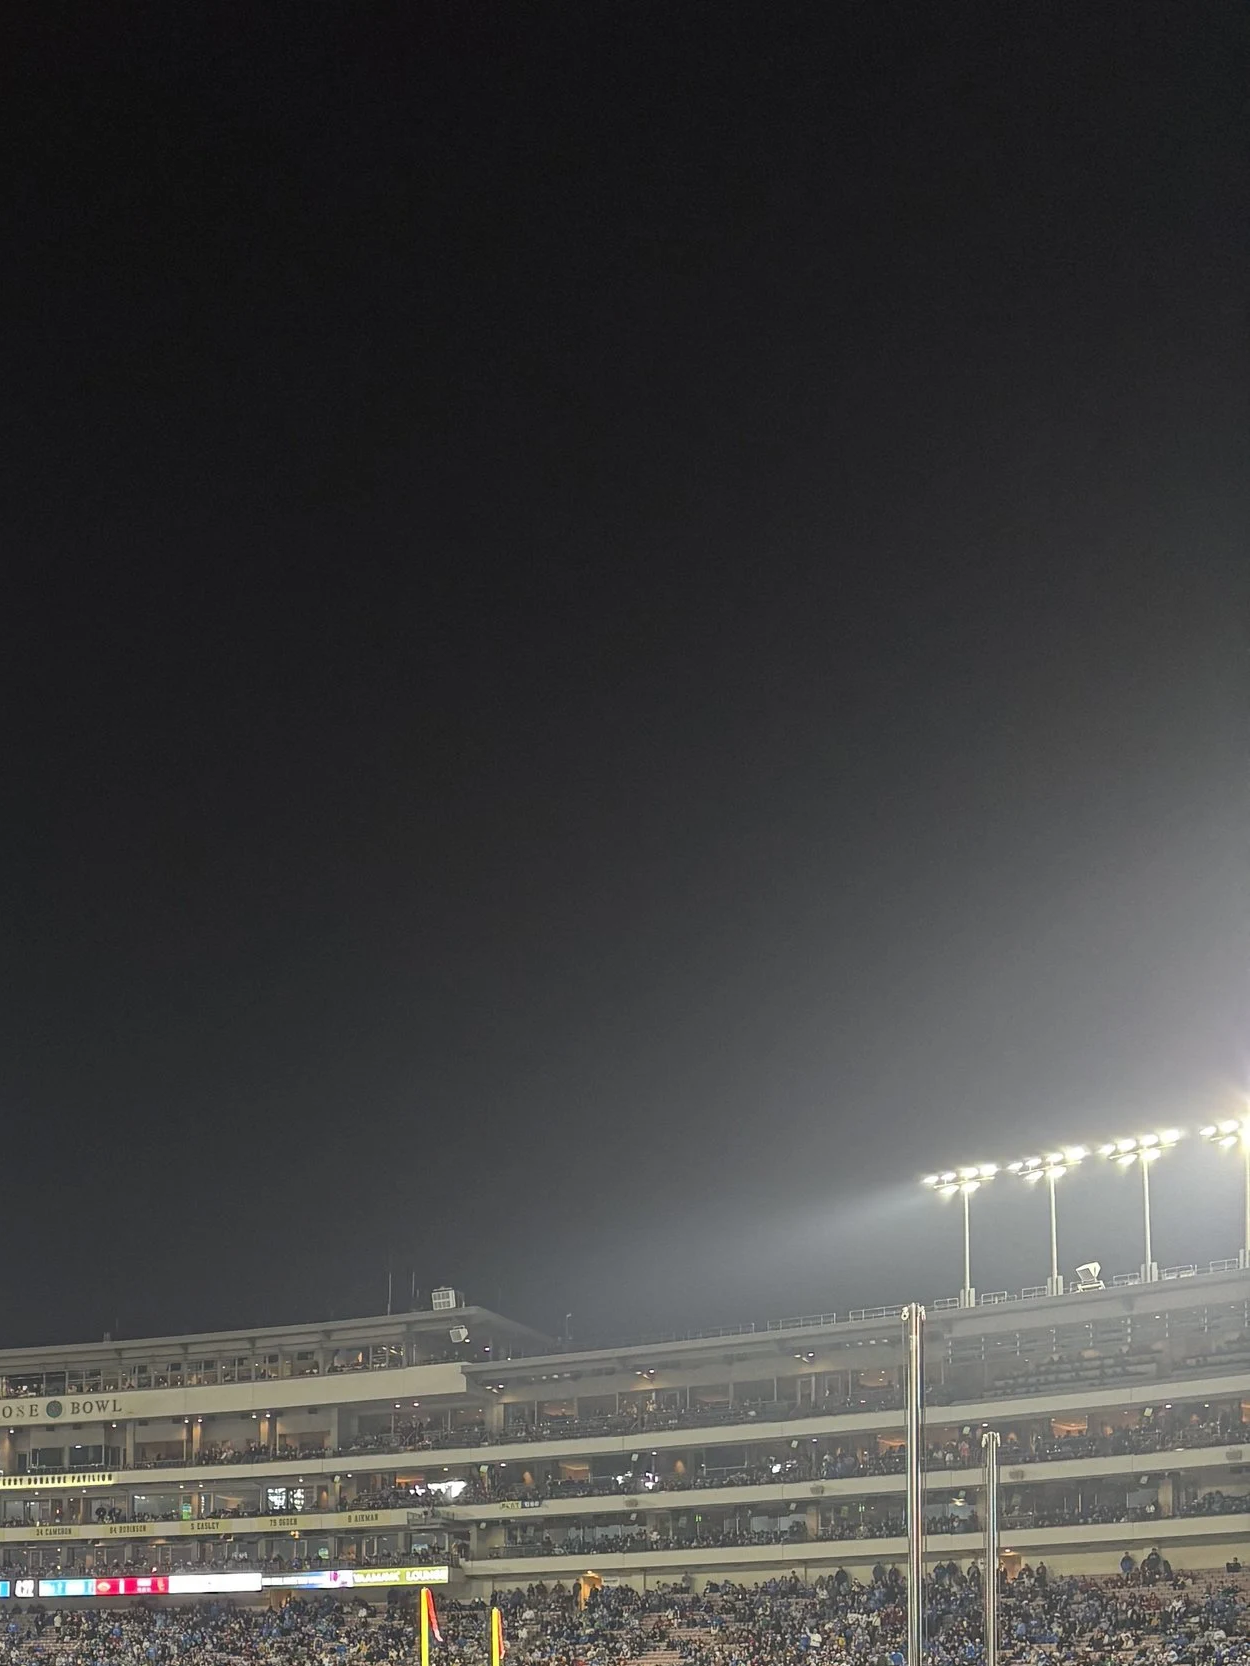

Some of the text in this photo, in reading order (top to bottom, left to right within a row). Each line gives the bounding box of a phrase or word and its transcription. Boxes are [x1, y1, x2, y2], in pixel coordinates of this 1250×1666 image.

[71, 1400, 123, 1415] BOWL
[71, 1474, 113, 1483] PAVILION
[196, 1521, 220, 1530] EASLEY
